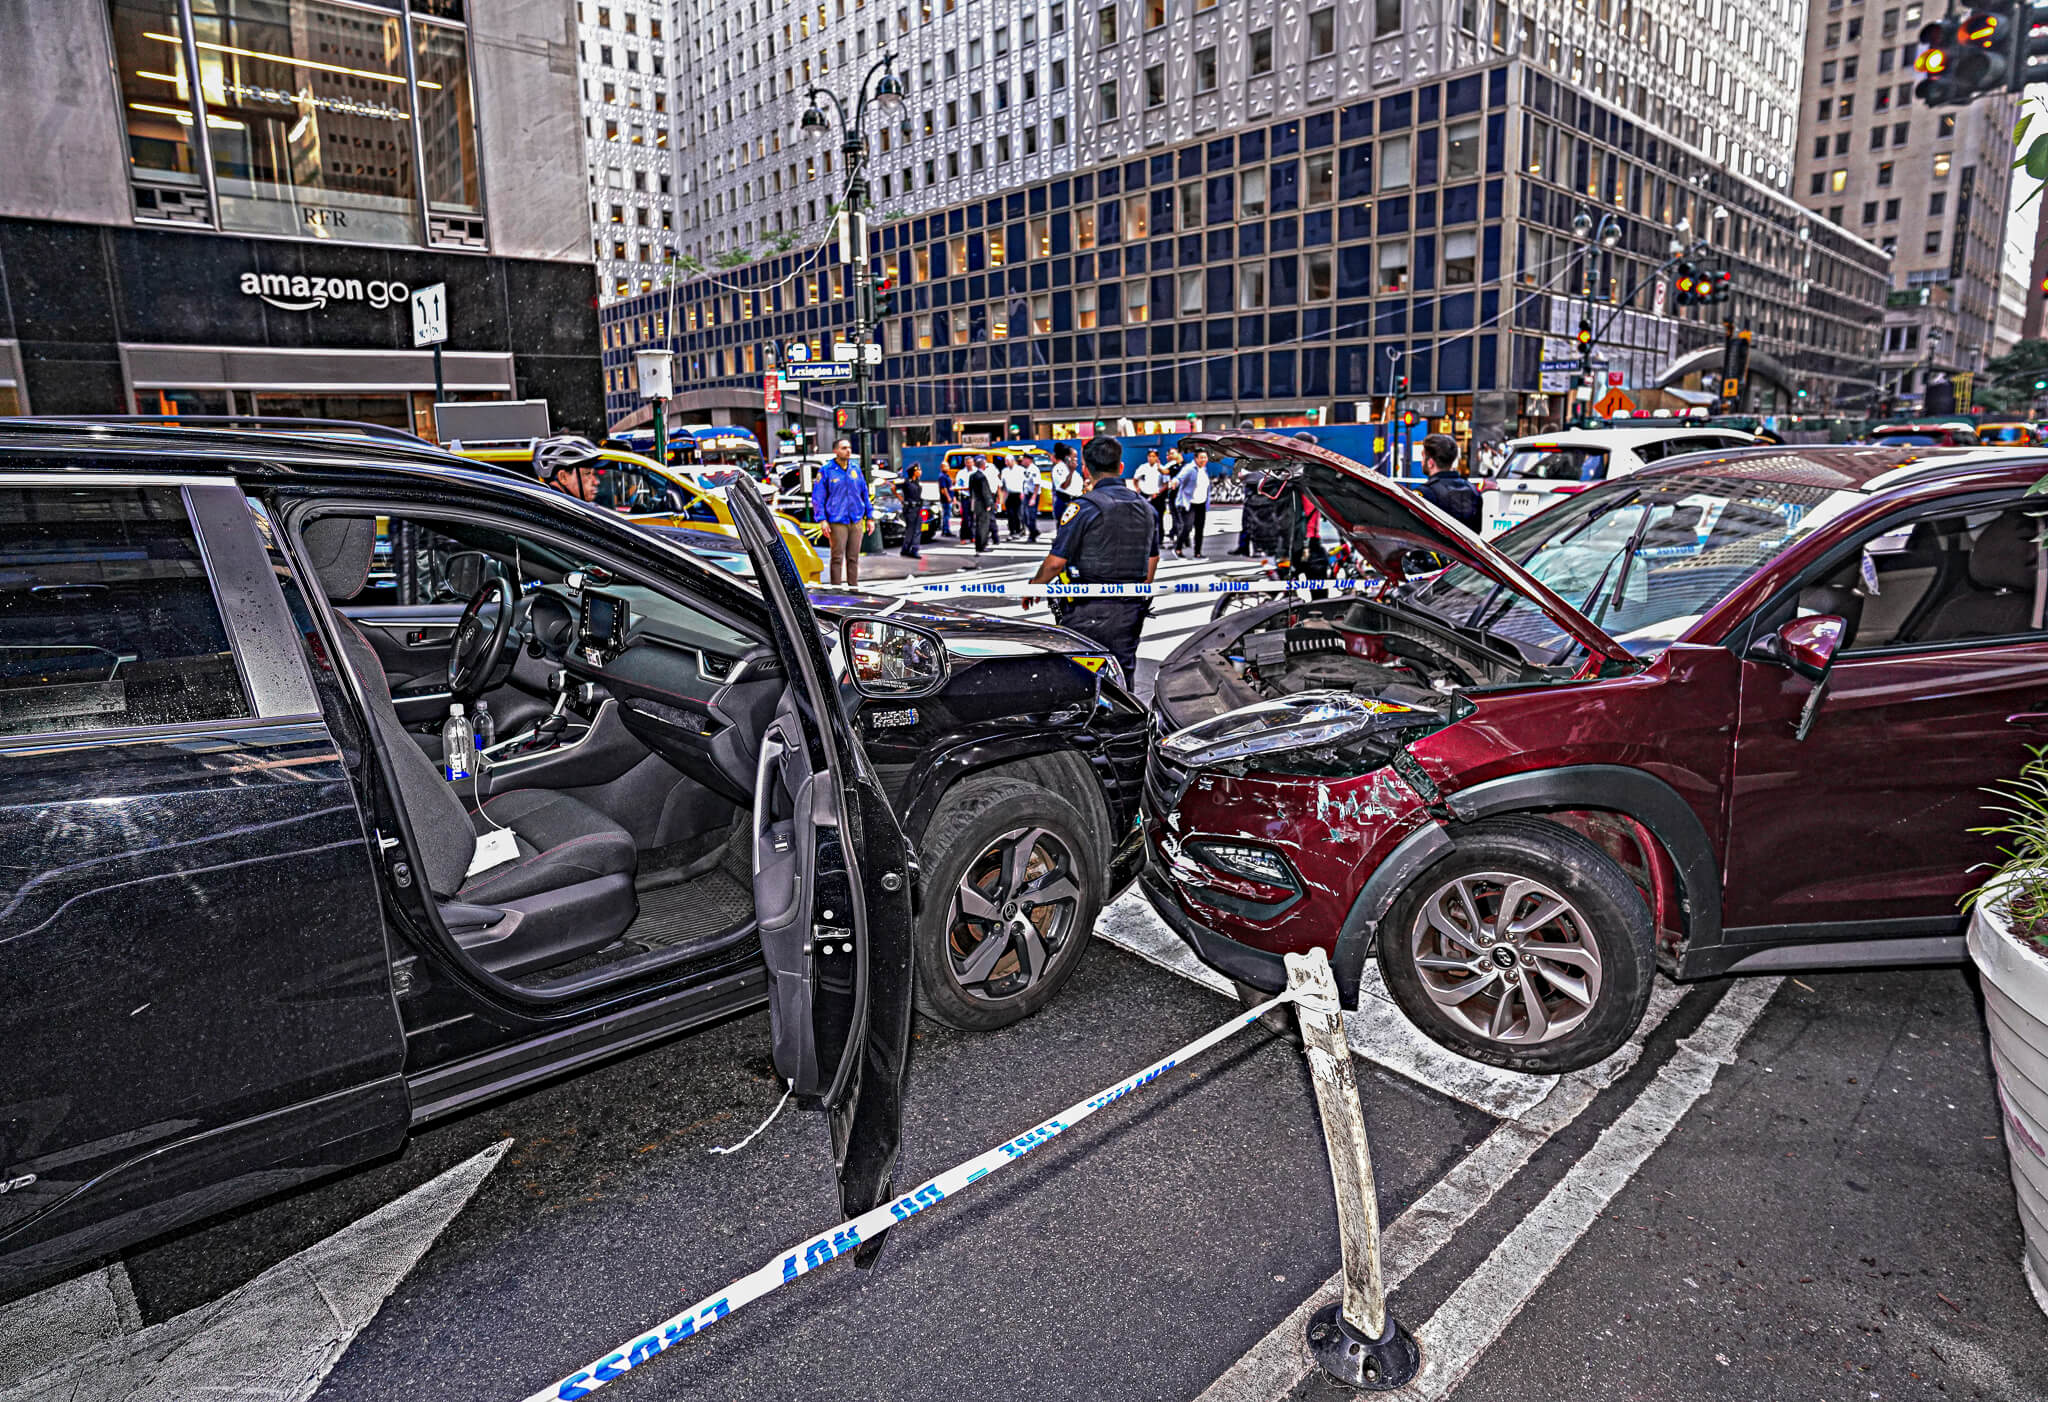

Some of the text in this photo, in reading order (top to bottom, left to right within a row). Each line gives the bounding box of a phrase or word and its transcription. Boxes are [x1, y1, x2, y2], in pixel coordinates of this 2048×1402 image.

[303, 207, 348, 228] RFR
[240, 272, 410, 309] amazon go
[789, 365, 850, 378] Lexington Ave
